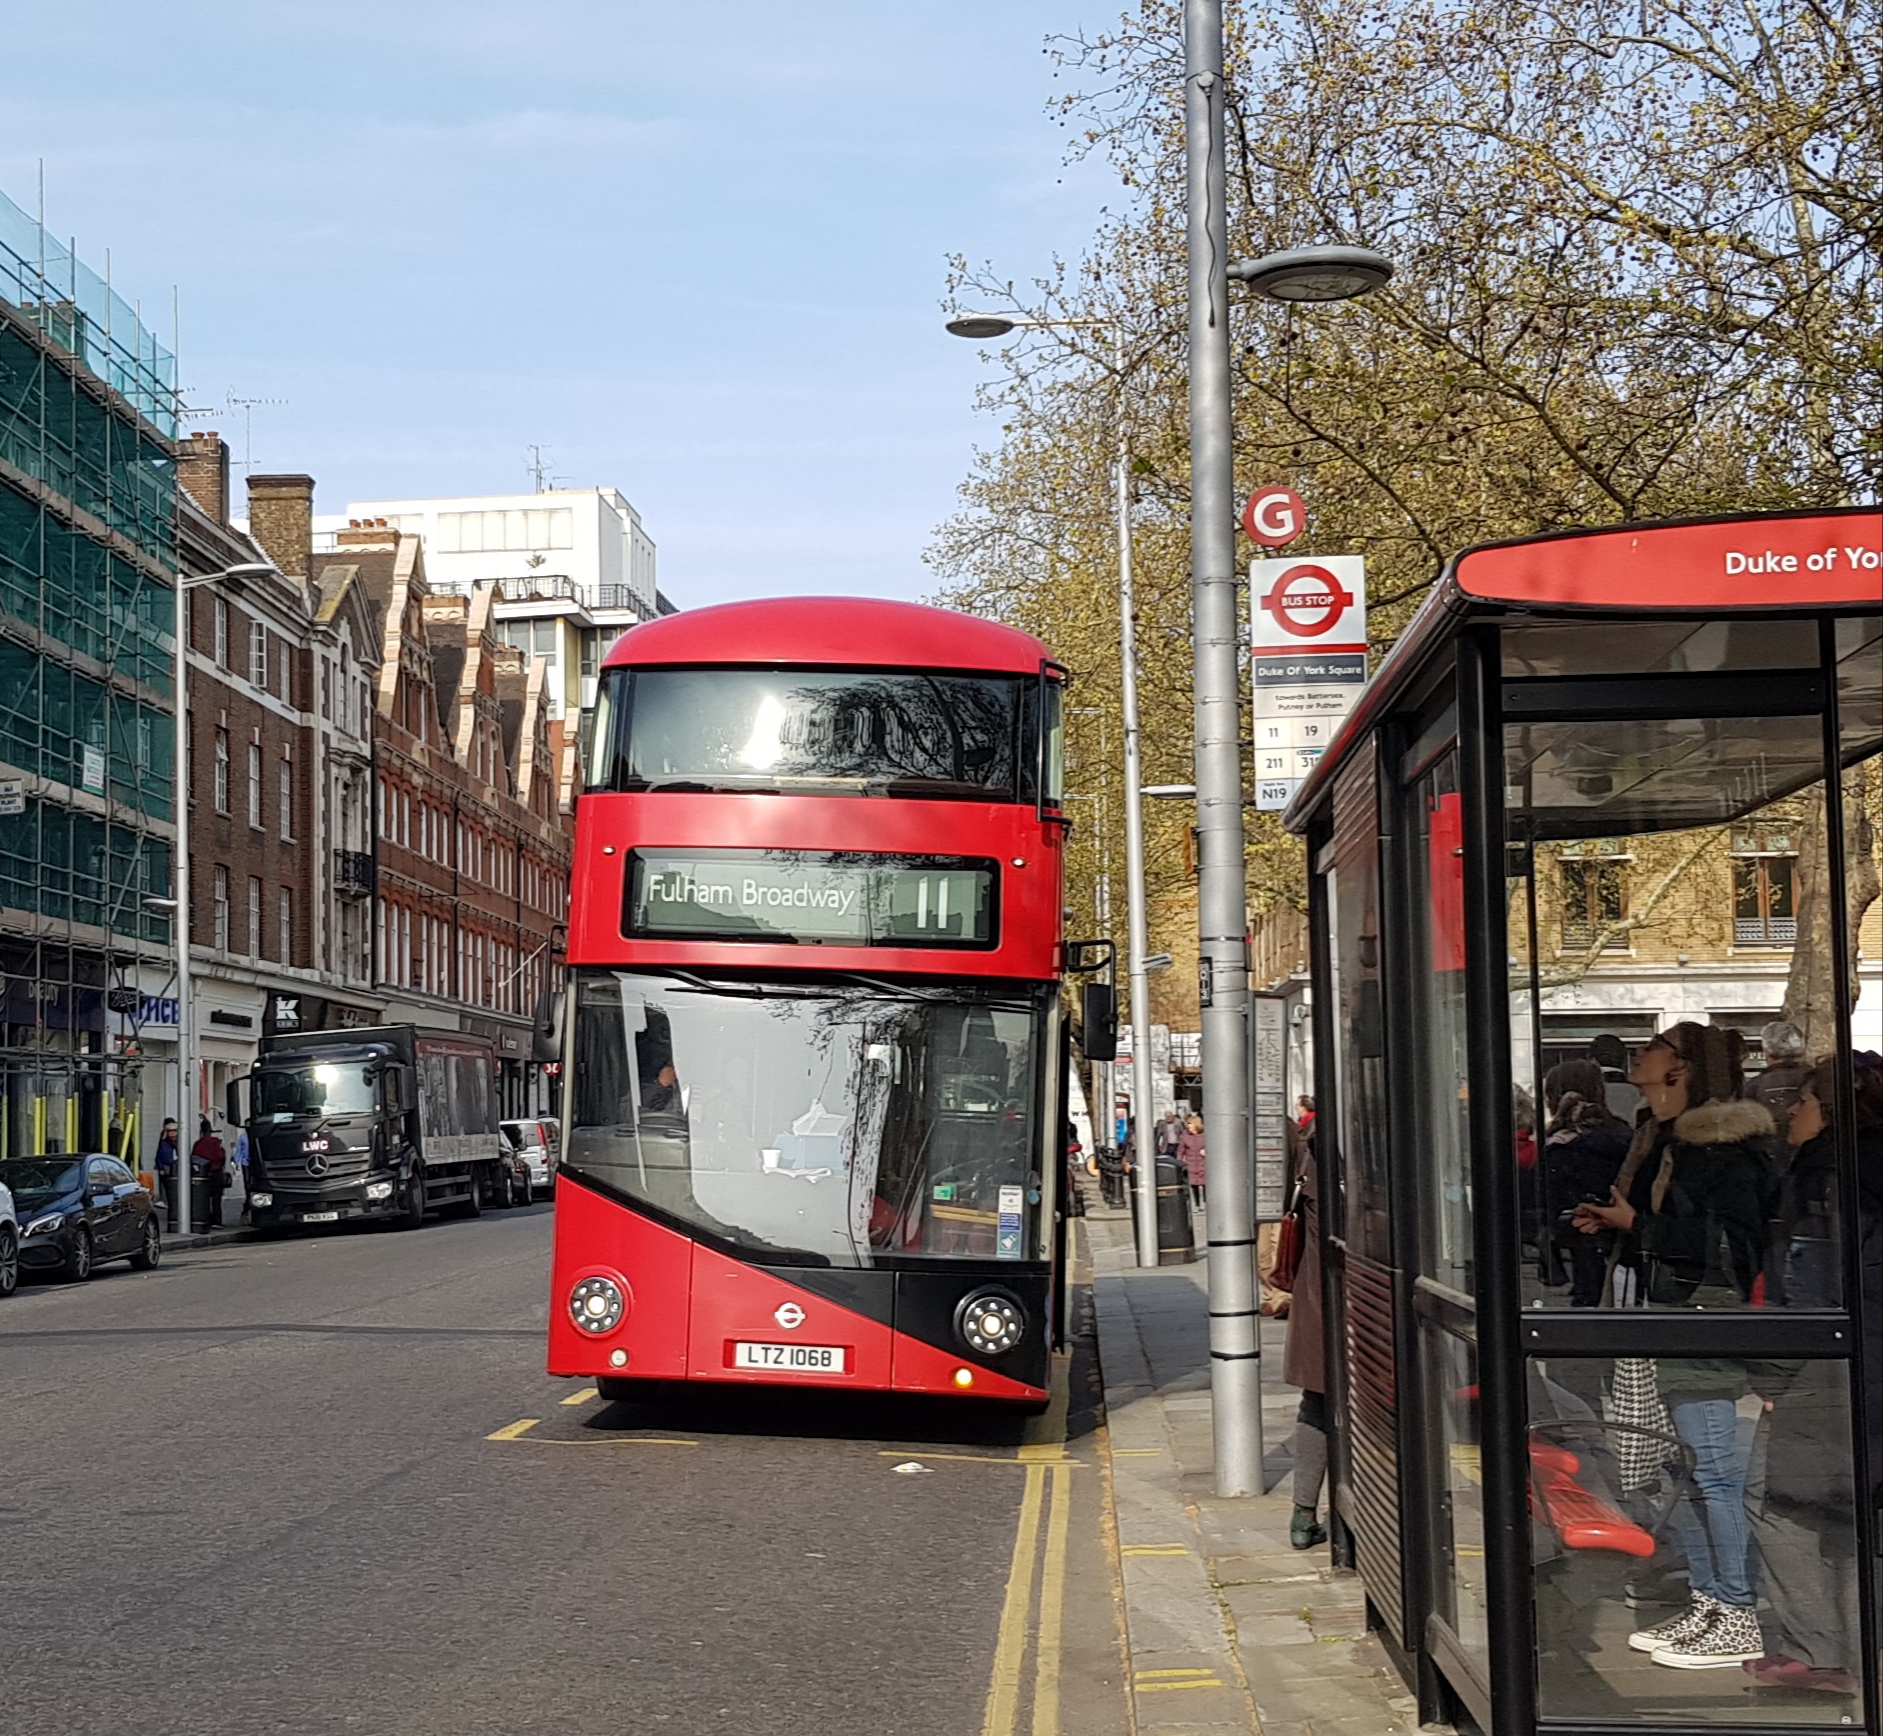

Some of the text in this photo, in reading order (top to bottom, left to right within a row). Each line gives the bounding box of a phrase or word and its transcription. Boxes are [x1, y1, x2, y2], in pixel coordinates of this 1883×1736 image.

[1254, 493, 1295, 538] G
[1725, 546, 1882, 575] Duke of Yo
[1281, 595, 1335, 607] BUS STOP
[1258, 665, 1362, 677] Duke Of York Square
[1268, 725, 1318, 738] 11 19
[1265, 757, 1283, 769] 211
[1262, 787, 1287, 800] N19
[649, 874, 949, 929] Fulham Broadway 11
[302, 1139, 329, 1152] LWC
[747, 1345, 832, 1367] LTZ 1068
